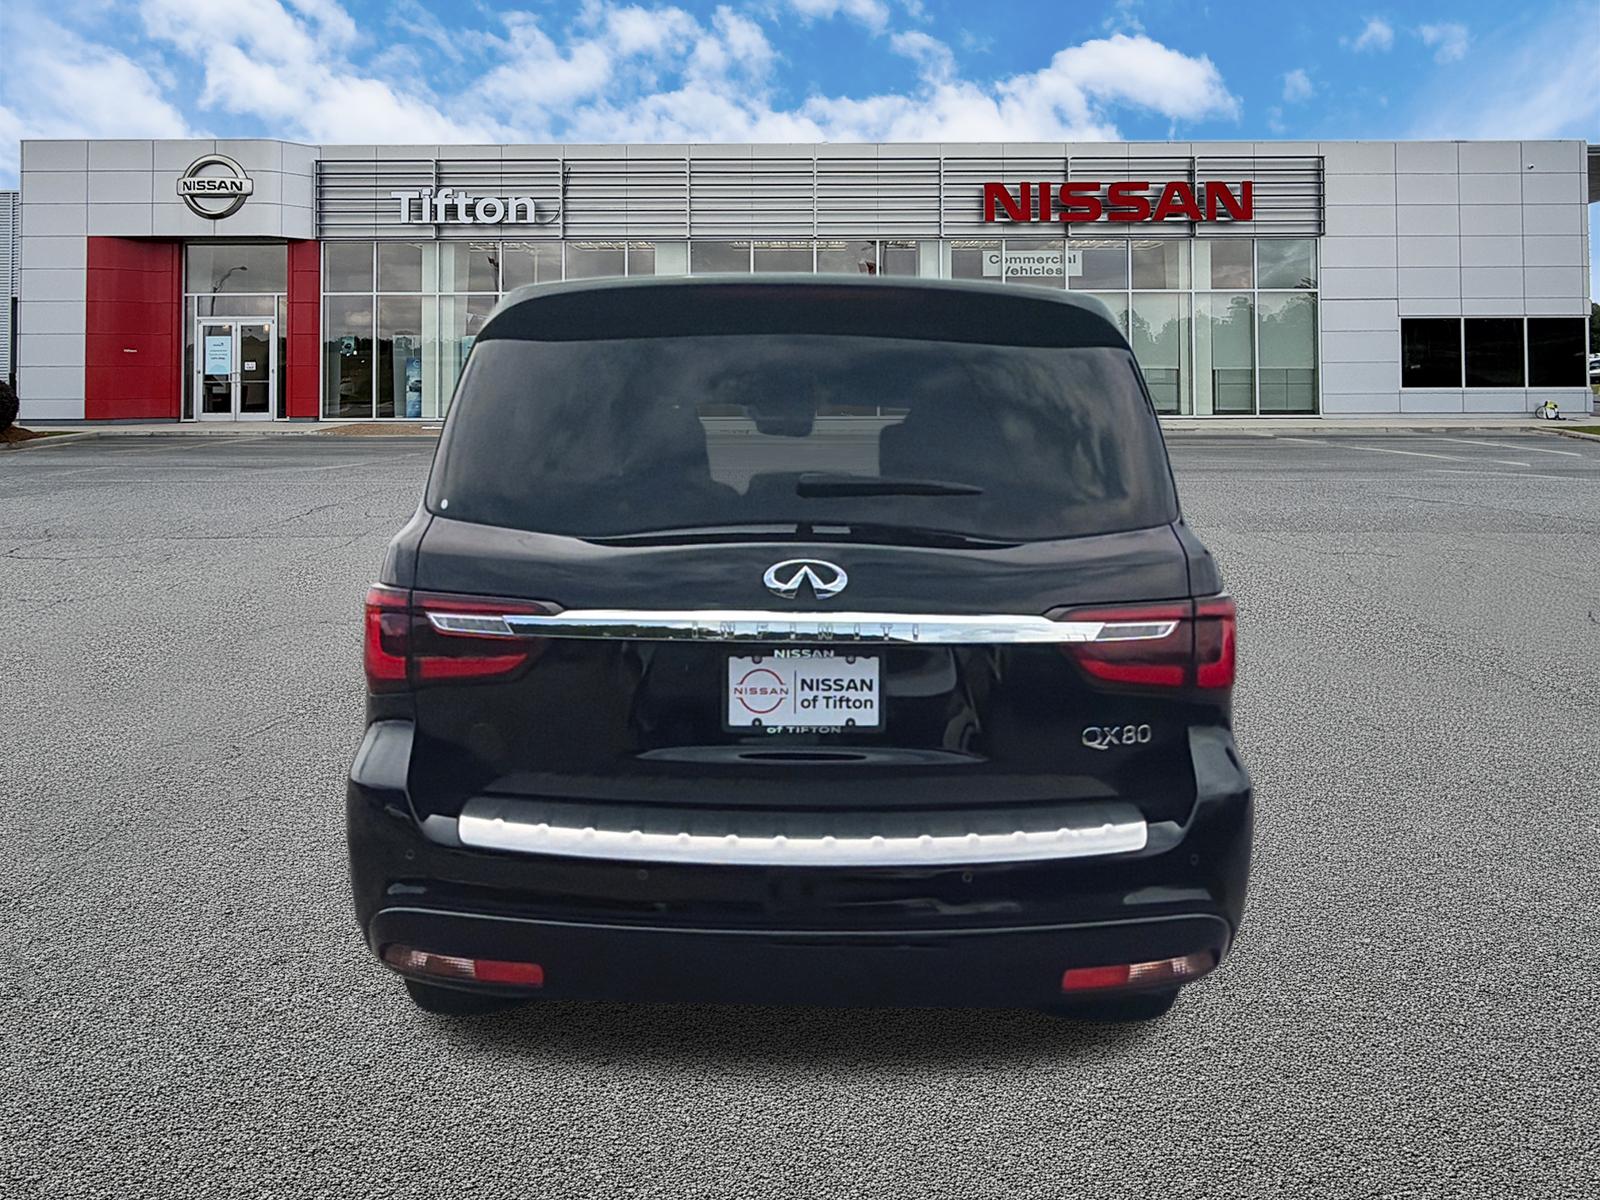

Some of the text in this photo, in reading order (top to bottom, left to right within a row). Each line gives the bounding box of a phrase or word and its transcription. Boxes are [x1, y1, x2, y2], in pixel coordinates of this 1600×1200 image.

[182, 180, 244, 192] NISSAN
[390, 188, 536, 224] Tifton
[983, 180, 1253, 222] NISSAN
[691, 620, 920, 641] INFINITI
[773, 649, 835, 659] NISSAN
[733, 687, 789, 695] NISSAN
[800, 678, 874, 692] NISSAN
[800, 696, 874, 710] of Tifton
[766, 725, 842, 734] of TIFTON
[1081, 724, 1152, 750] QX80
